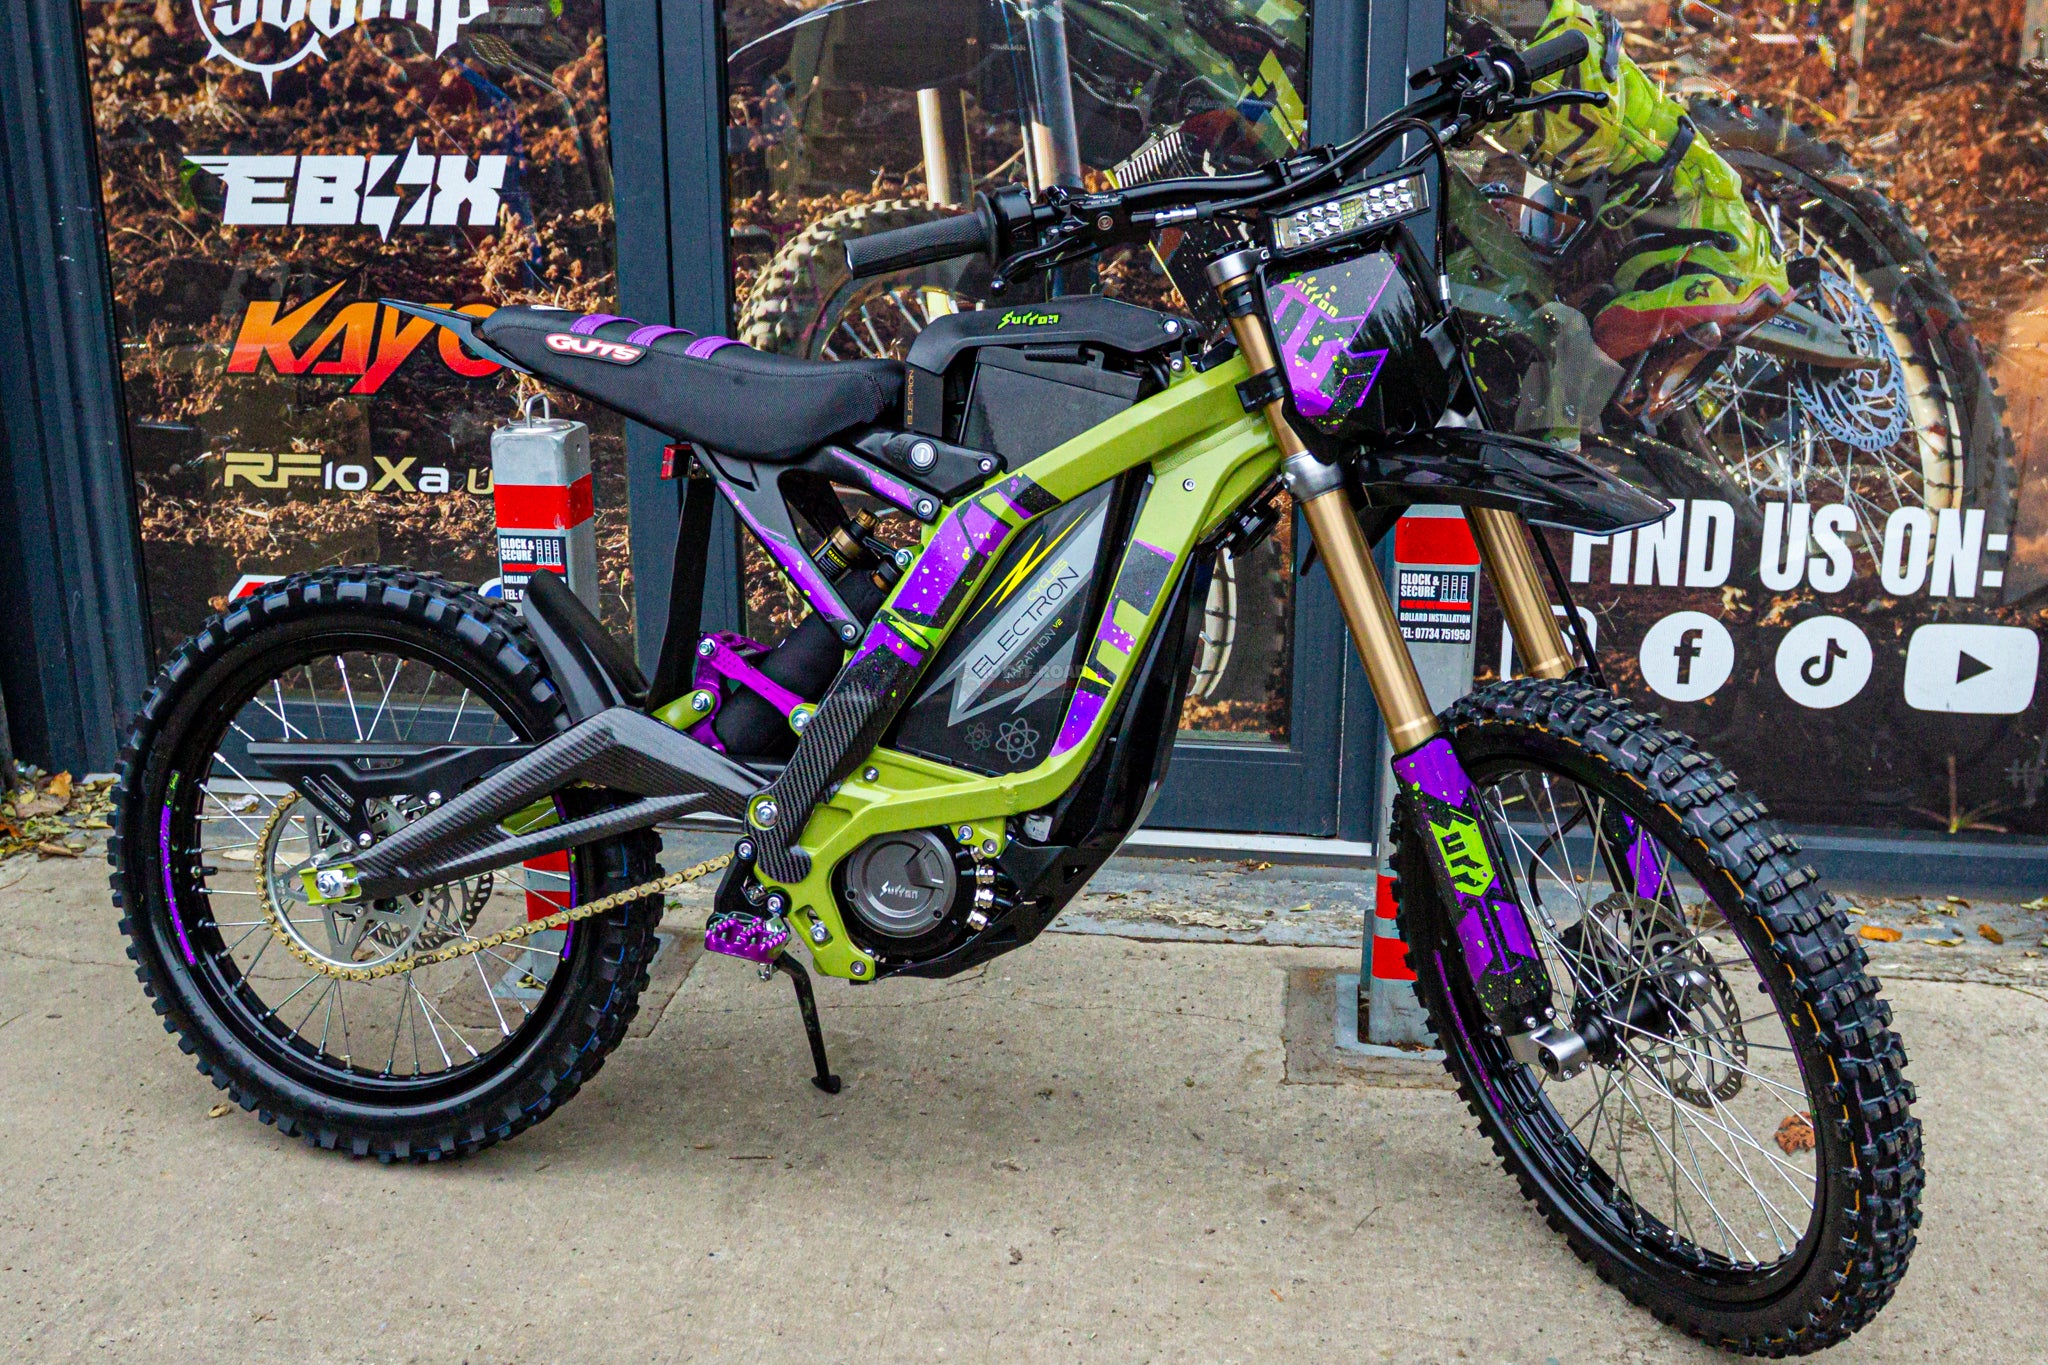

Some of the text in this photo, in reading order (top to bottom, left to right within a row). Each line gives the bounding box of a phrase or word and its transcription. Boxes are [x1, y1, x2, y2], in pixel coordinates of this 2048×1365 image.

[997, 310, 1059, 330] Surron
[226, 279, 503, 394] KAYO
[546, 333, 642, 362] GUTS
[500, 538, 535, 549] BLOCK &
[1570, 499, 2008, 598] FIND US ON:
[501, 550, 532, 561] SECURE
[504, 575, 528, 584] BOLLARD
[1028, 558, 1068, 601] CYCLES
[1401, 573, 1440, 586] BLOCK &
[504, 589, 518, 600] TEL:
[1401, 586, 1435, 598] SECURE
[971, 566, 1079, 680] ELECTRON
[1400, 613, 1471, 623] BOLLARD INSTALLATION
[1415, 628, 1440, 640] 07734
[1441, 629, 1470, 641] 751958
[1003, 618, 1064, 684] MARATHON V2
[879, 880, 919, 899] Surron
